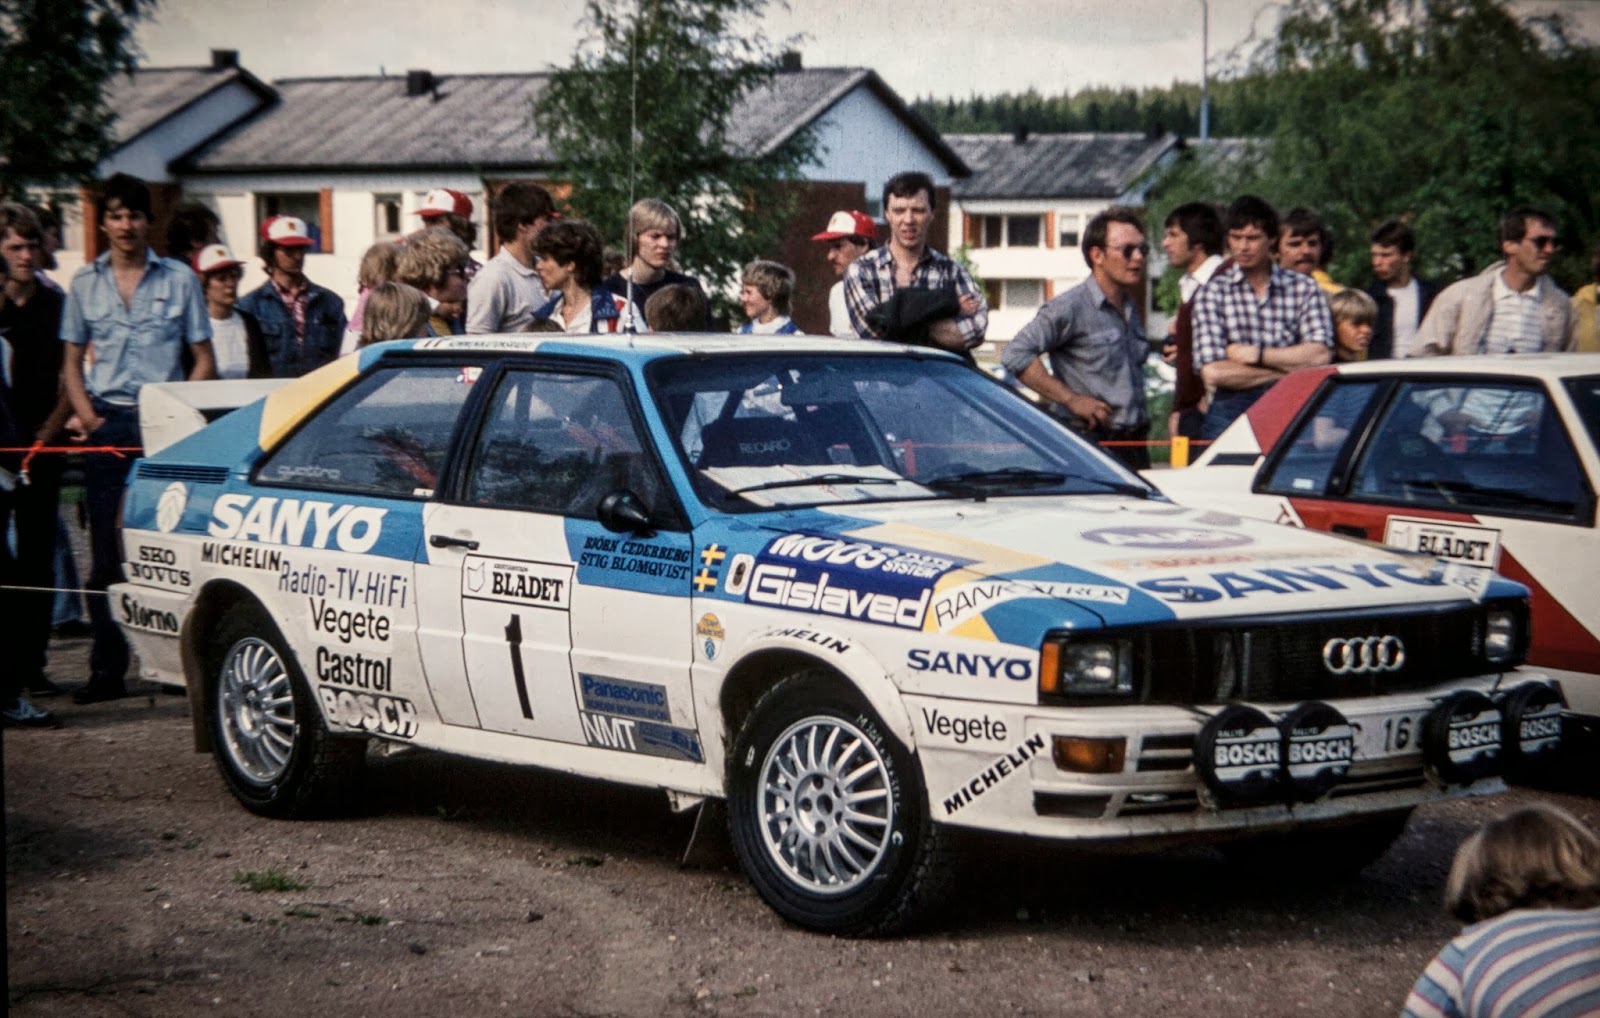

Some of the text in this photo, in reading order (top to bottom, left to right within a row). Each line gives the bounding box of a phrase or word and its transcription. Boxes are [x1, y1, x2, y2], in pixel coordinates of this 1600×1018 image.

[207, 493, 389, 554] SANYO
[201, 542, 282, 572] MICHELIN
[621, 542, 691, 562] CEDERBERG
[1419, 535, 1490, 561] BLADET
[580, 552, 690, 580] STIG BLOMQVIST
[278, 560, 409, 609] Radio-TV-HiFi
[492, 571, 564, 602] BLADET
[749, 564, 931, 629] Gislaved
[121, 593, 179, 633] Storno
[309, 597, 390, 643] Vegete
[316, 646, 392, 692] Castrol
[505, 614, 534, 721] 1
[907, 649, 1032, 681] SANYO
[581, 673, 666, 706] Panasonic
[319, 686, 418, 738] BOSCH
[922, 707, 1007, 744] Vegete
[1520, 716, 1562, 740] BOSCH
[581, 711, 637, 751] NMT
[1449, 723, 1500, 749] BOSCH
[1215, 741, 1280, 767] BOSCH
[1288, 739, 1351, 763] BOSCH
[943, 733, 1045, 815] MICHELIN
